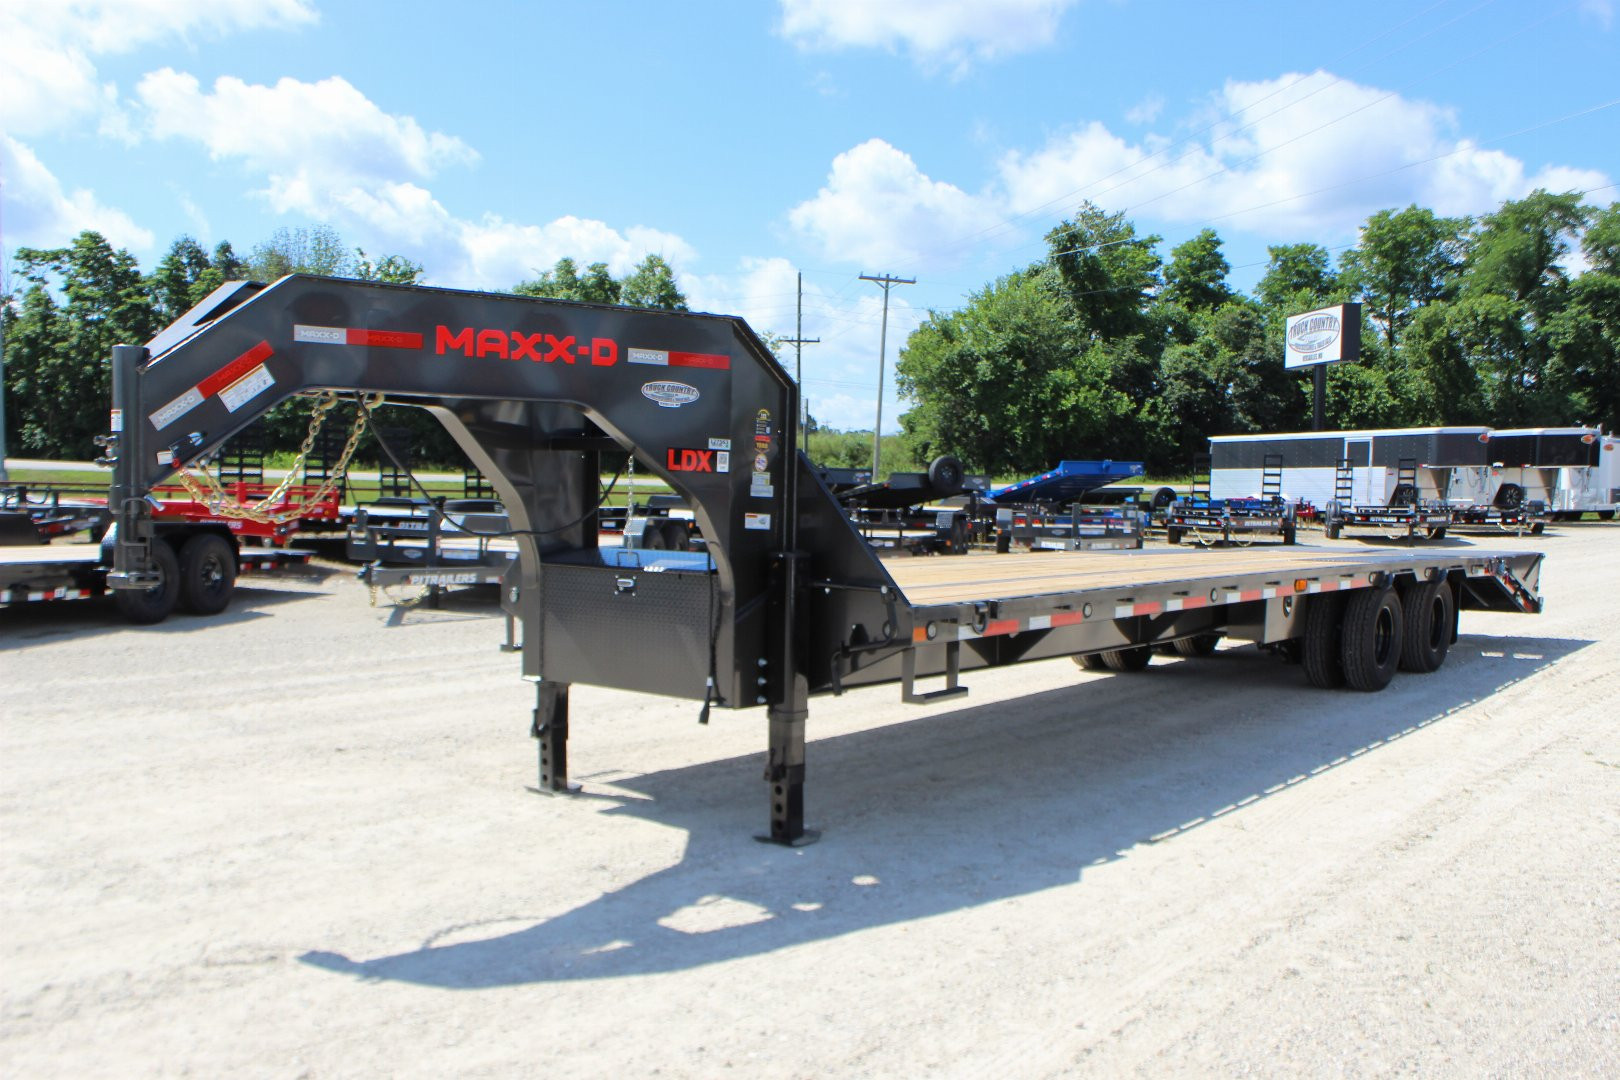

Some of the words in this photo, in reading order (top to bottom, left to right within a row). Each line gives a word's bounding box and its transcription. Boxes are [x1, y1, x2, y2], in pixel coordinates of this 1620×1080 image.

[300, 330, 340, 339] MAXX-D
[1290, 320, 1309, 339] TRUCK
[1310, 317, 1338, 330] COUNTRY
[435, 325, 618, 367] MAXX-D
[667, 384, 695, 394] COUNTRY
[668, 448, 712, 472] LDX
